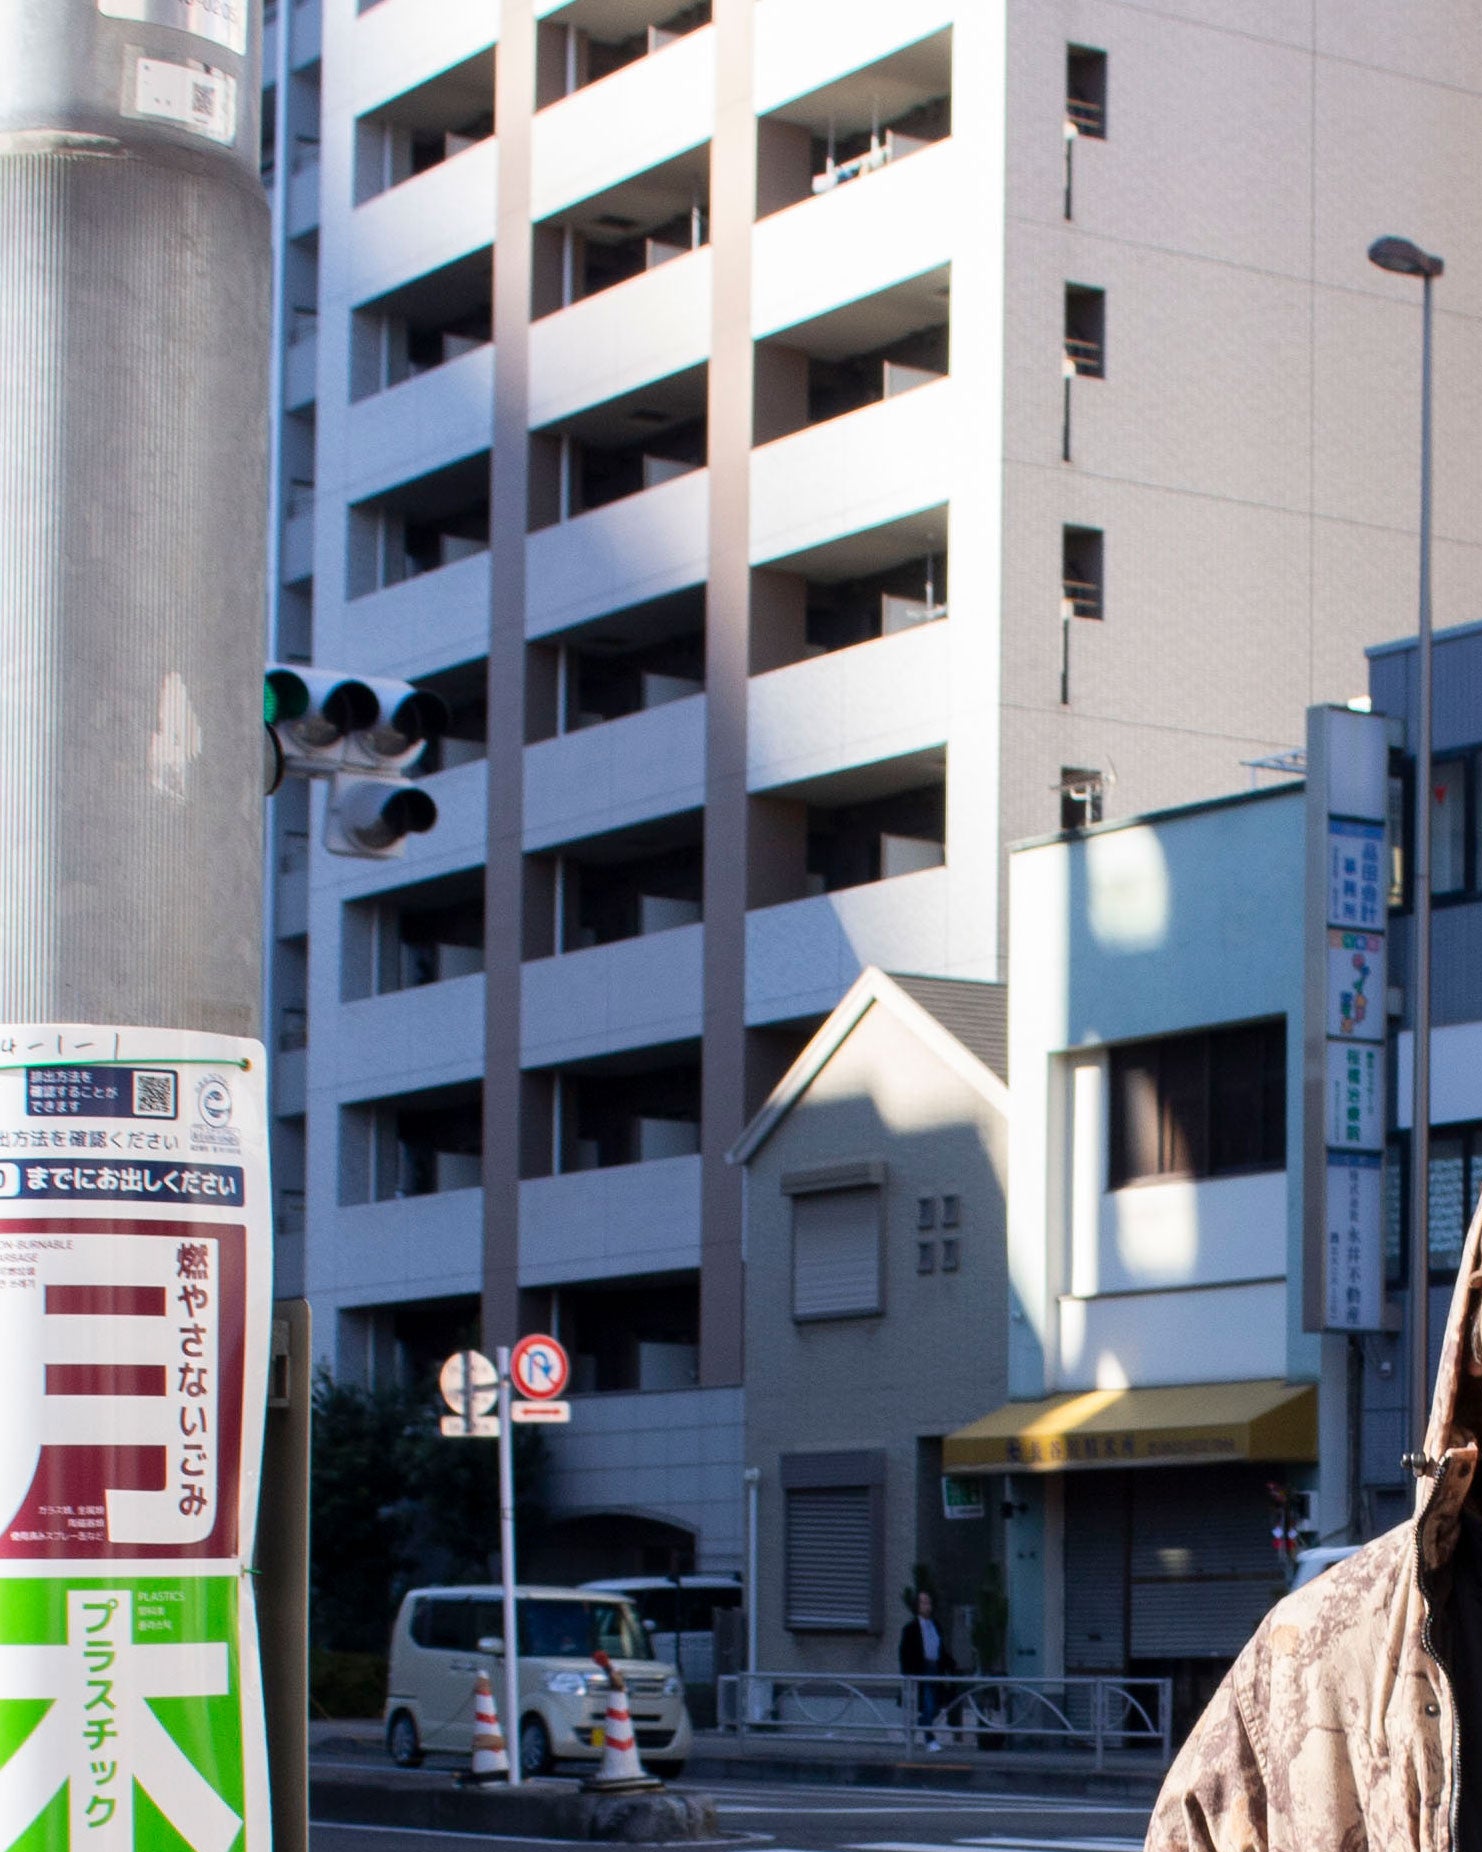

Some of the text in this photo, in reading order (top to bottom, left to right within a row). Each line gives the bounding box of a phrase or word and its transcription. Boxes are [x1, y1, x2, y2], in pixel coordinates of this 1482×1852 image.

[29, 1084, 119, 1100] 確認することが
[29, 1100, 81, 1114] できます
[26, 1166, 236, 1196] までにお出しください
[176, 1242, 209, 1518] 燃やさないごみ
[137, 1591, 186, 1602] PLASTICS
[81, 1597, 119, 1829] プラスチック
